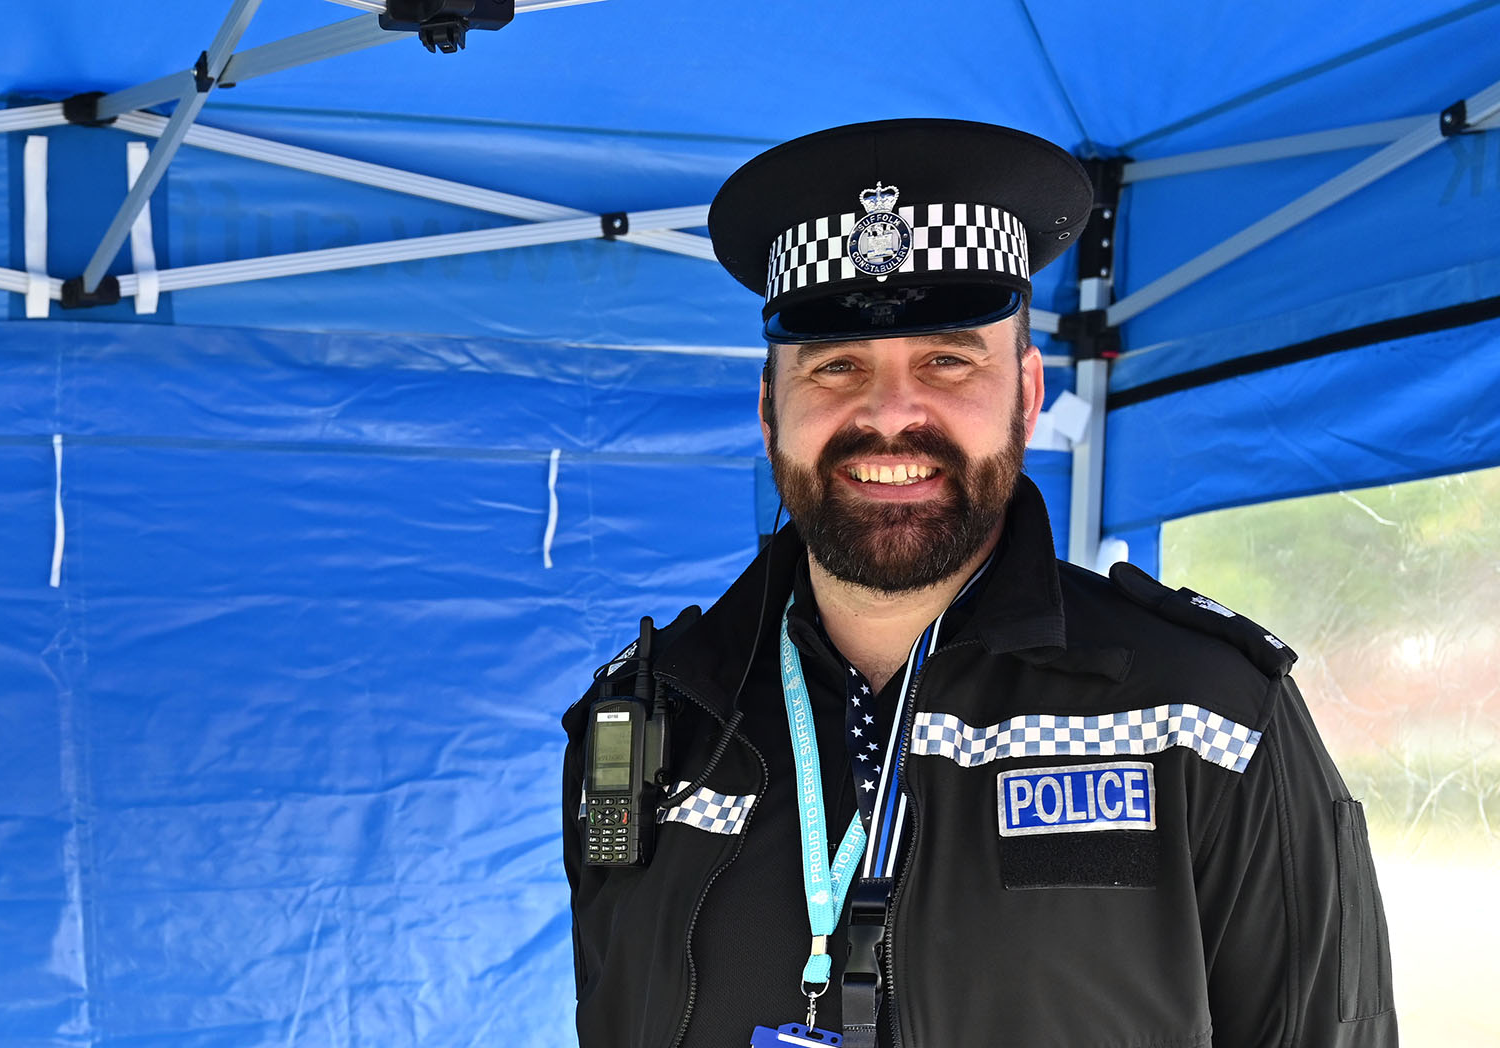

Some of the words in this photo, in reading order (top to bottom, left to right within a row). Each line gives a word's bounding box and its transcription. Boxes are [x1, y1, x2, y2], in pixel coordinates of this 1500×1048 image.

[857, 213, 902, 232] SUFFOLK
[851, 245, 908, 273] CONSTABULARY
[791, 695, 812, 756] SUFFOLK
[802, 755, 817, 803] SERVE
[1009, 771, 1146, 826] POLICE
[806, 807, 818, 829] TO
[808, 829, 823, 883] PROUD
